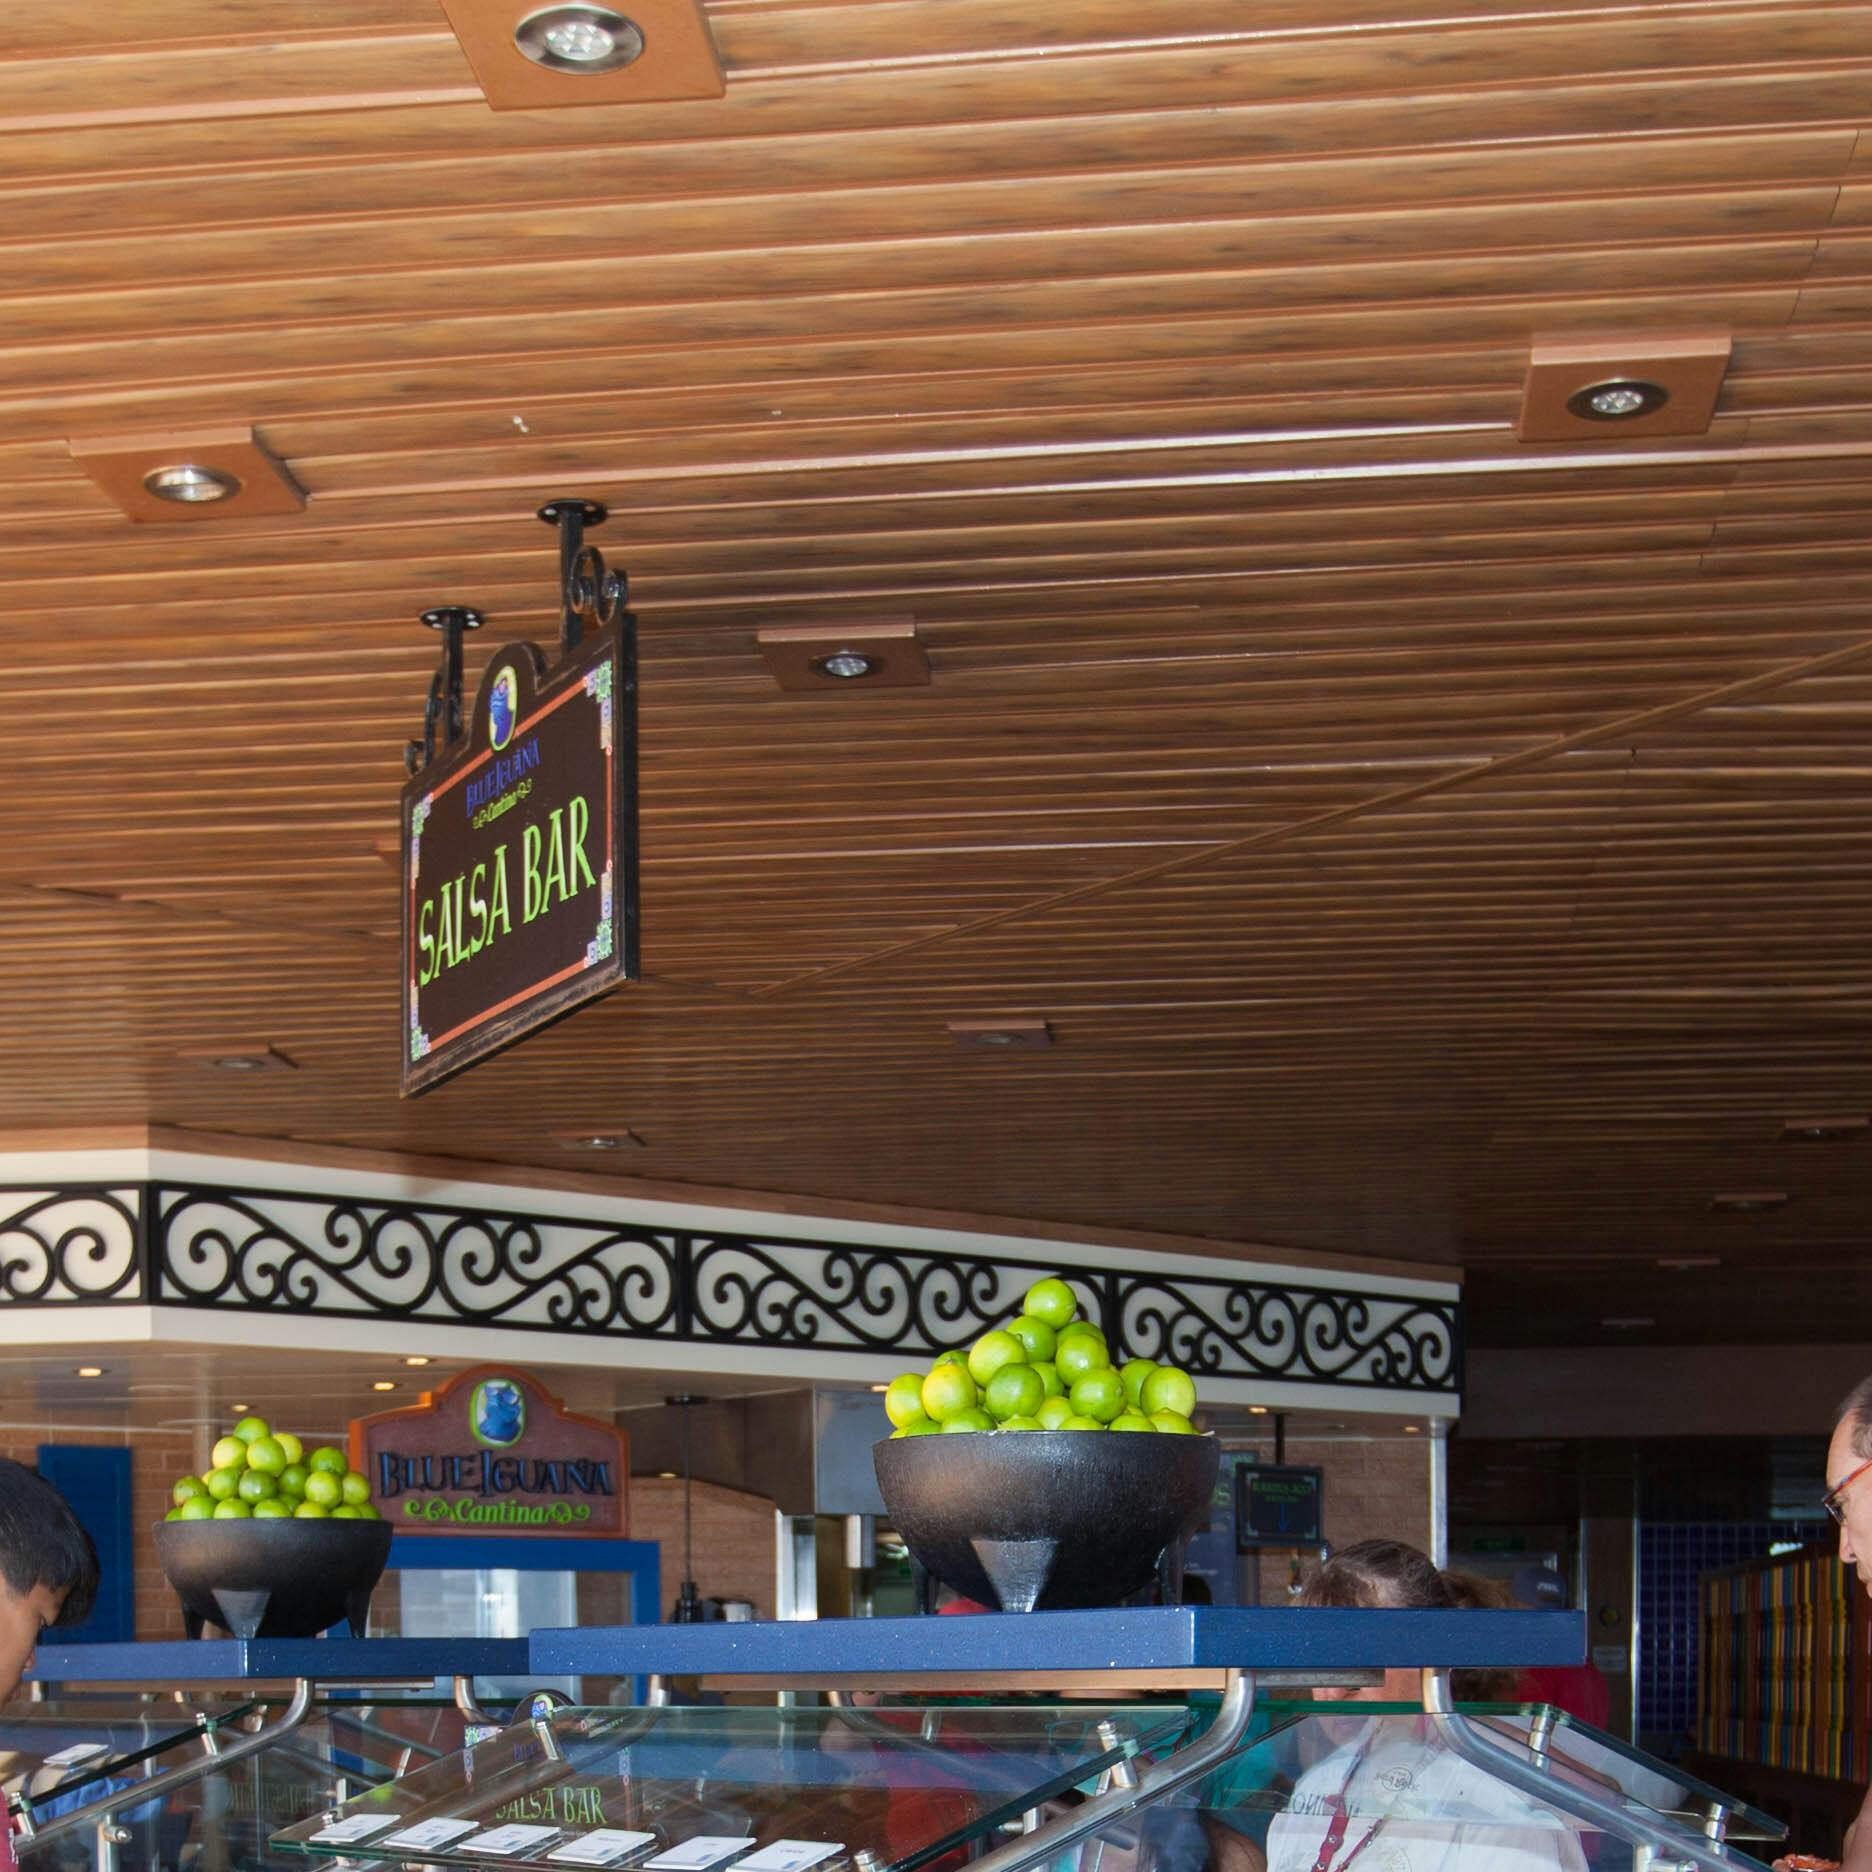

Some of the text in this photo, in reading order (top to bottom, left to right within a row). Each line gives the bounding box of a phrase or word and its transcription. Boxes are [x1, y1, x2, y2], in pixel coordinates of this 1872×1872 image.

[419, 796, 596, 987] SALSA BAR
[454, 1499, 549, 1524] Cantina
[563, 1786, 608, 1824] BAR
